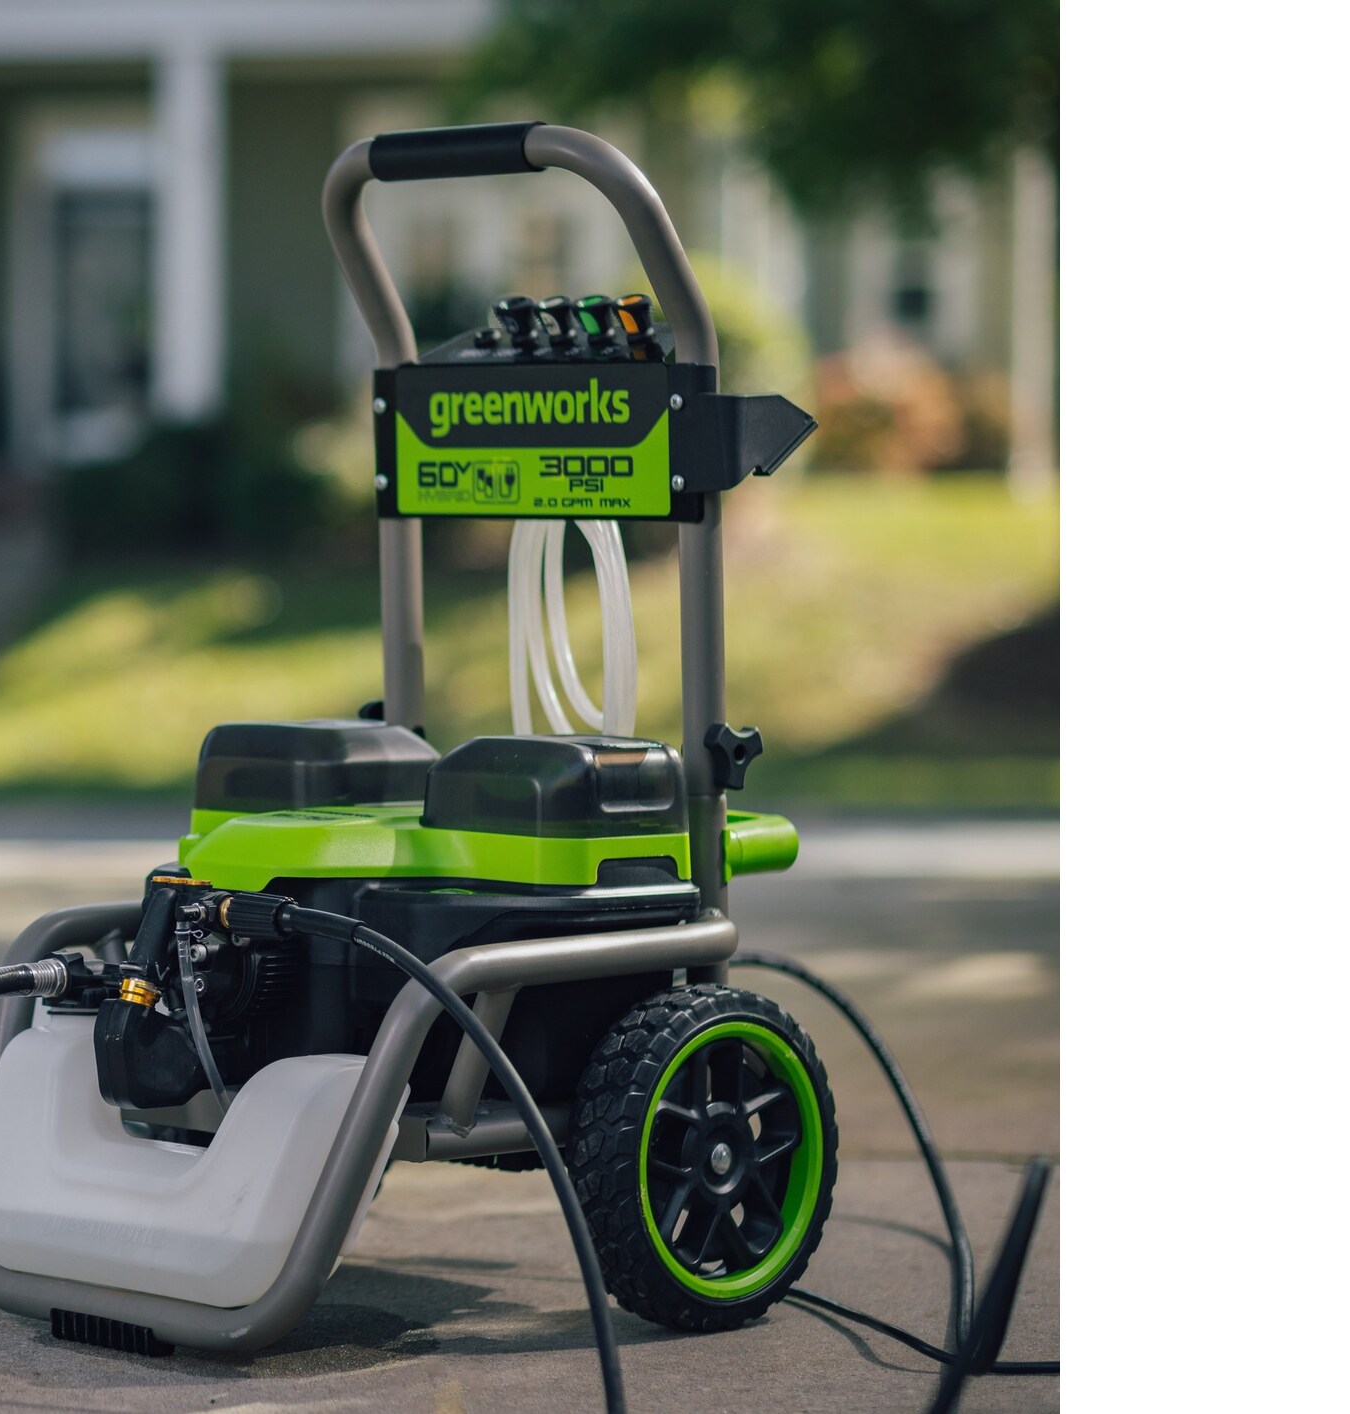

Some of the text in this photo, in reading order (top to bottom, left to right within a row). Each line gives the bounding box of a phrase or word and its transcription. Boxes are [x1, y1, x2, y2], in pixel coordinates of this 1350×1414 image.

[429, 377, 631, 439] greenworks
[539, 455, 634, 477] 3000
[569, 478, 605, 493] PSI
[561, 497, 594, 508] GPM
[599, 497, 631, 508] MAX
